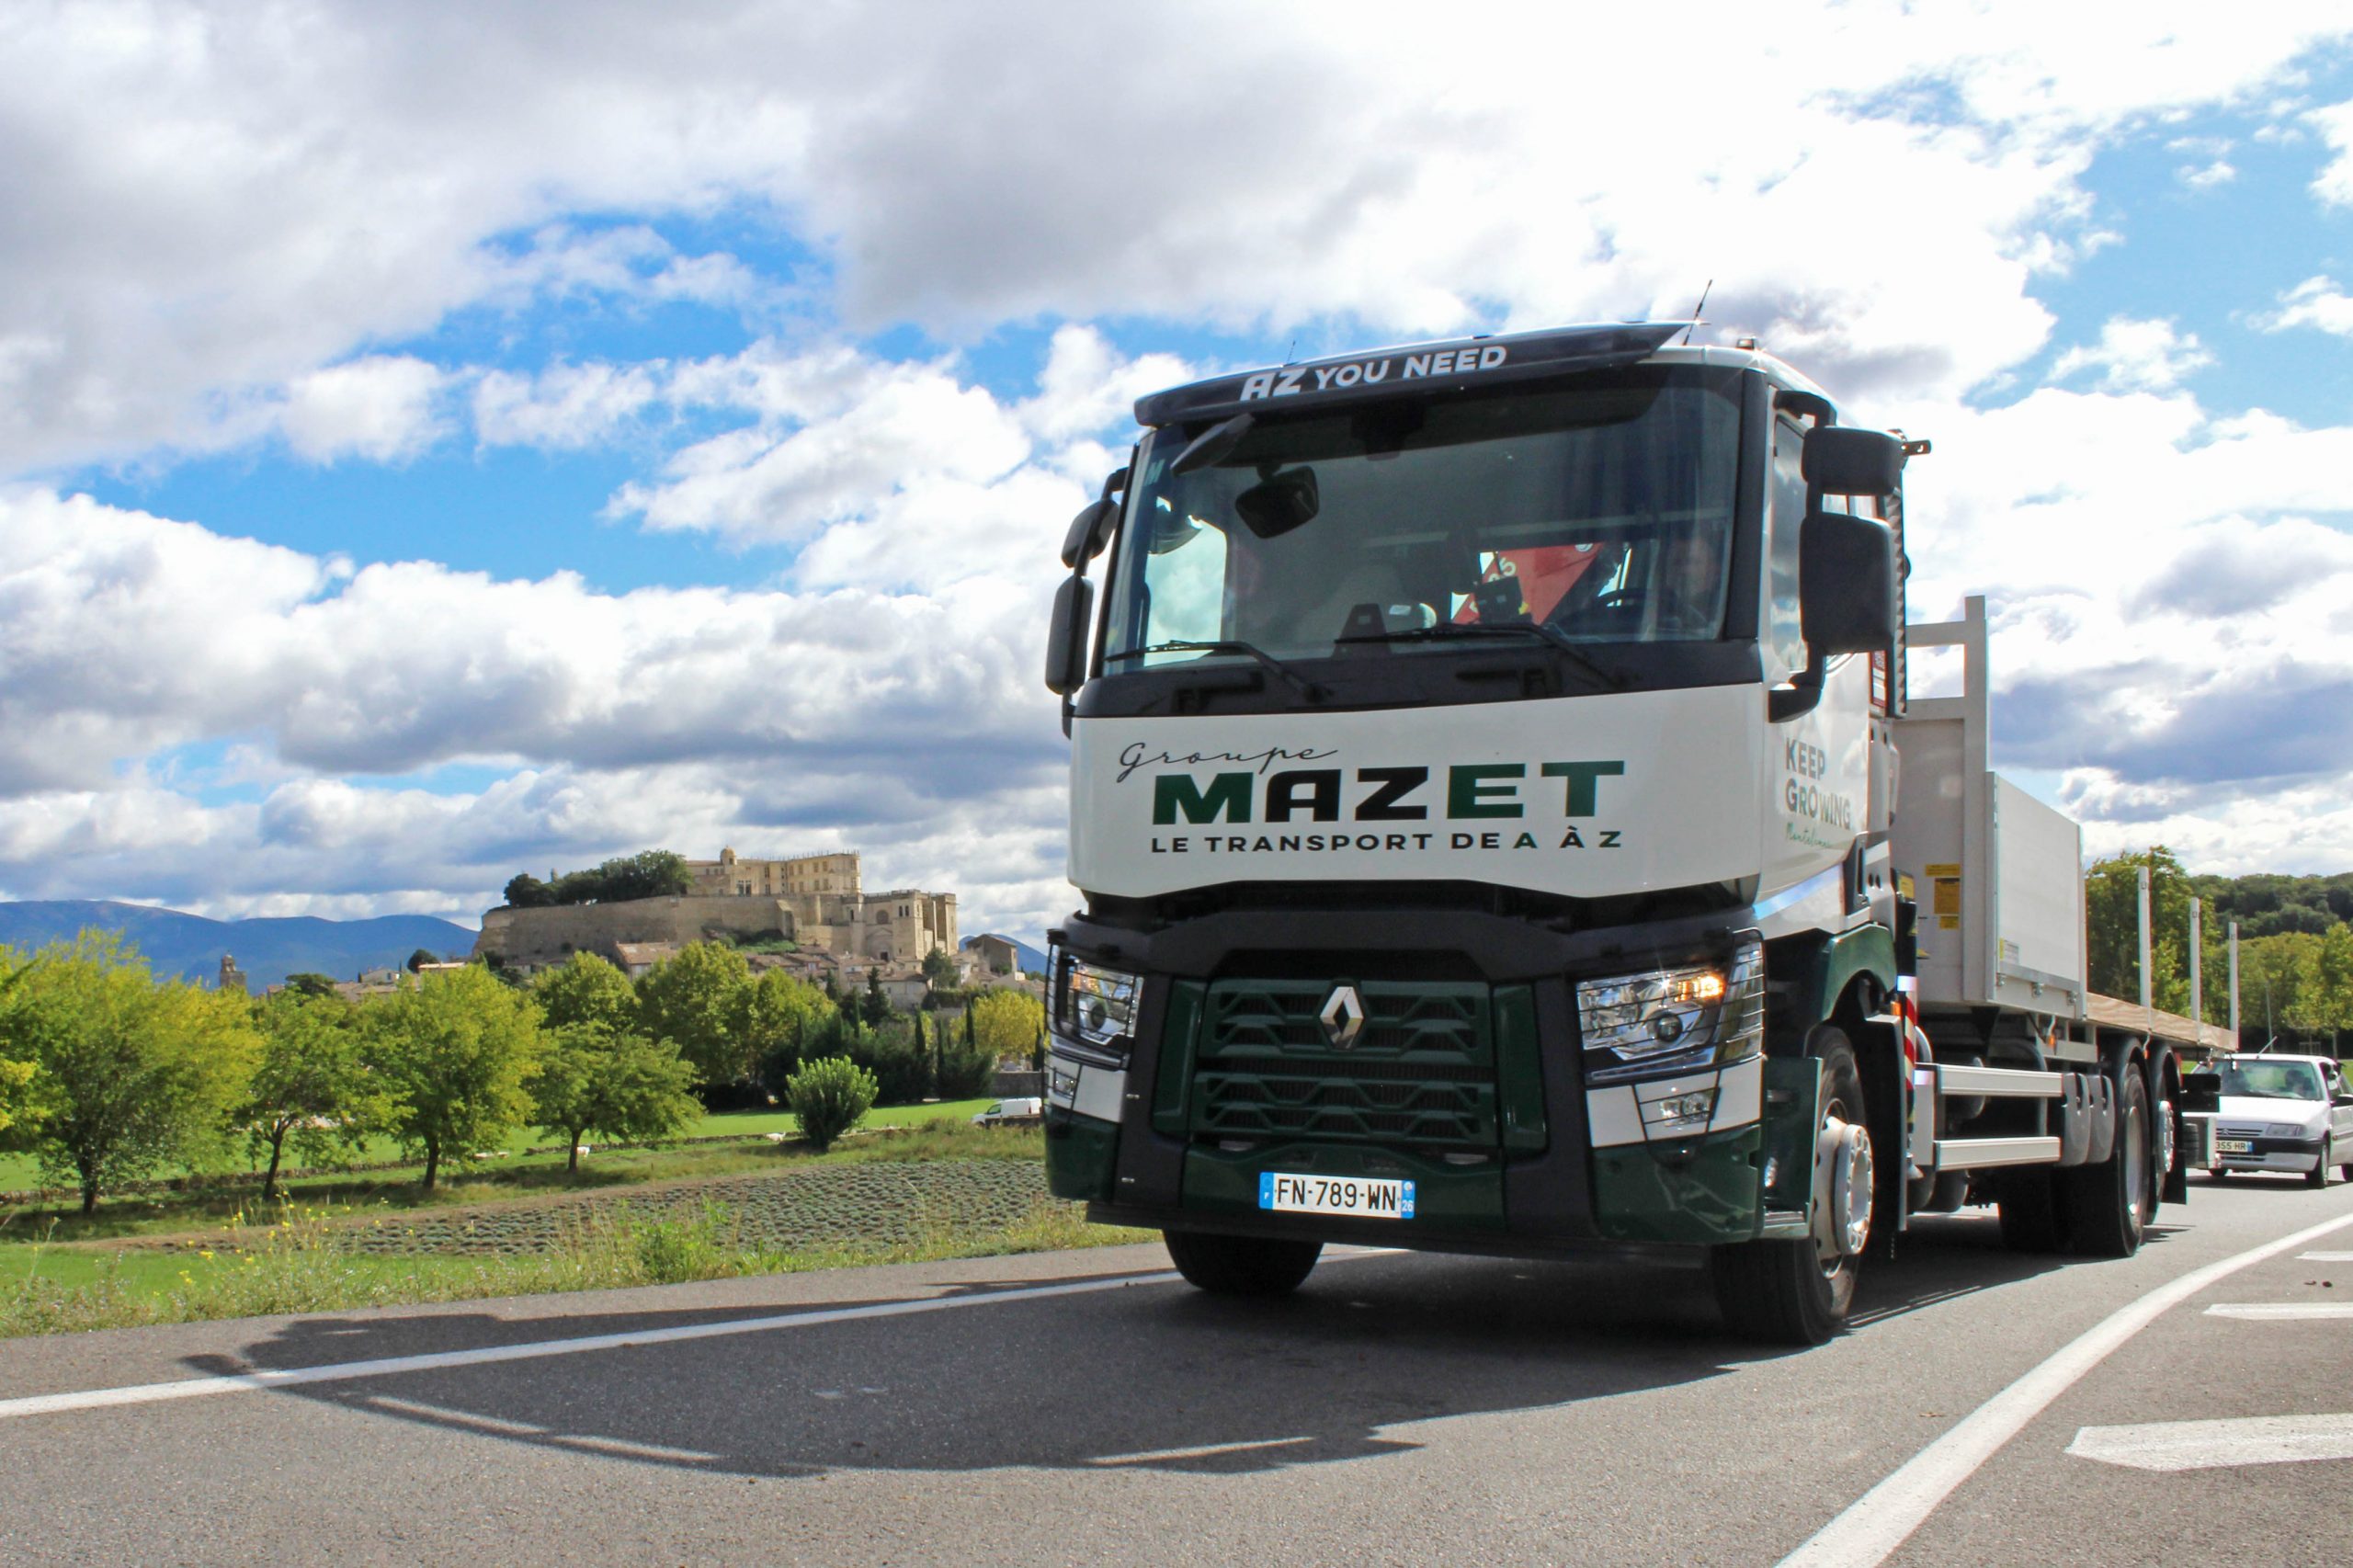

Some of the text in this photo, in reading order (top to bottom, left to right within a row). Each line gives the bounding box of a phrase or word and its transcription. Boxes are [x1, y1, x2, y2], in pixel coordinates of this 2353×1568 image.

[1240, 346, 1506, 401] AZ YOU NEED
[1117, 742, 1338, 783] Groupe
[1785, 737, 1825, 780] KEEP
[1152, 760, 1625, 825] MAZET
[1785, 778, 1851, 830] GROWING
[1152, 836, 1189, 853] LE
[1204, 834, 1433, 852] TRANSPORT
[1560, 825, 1585, 848] À
[1598, 831, 1621, 847] Z
[1277, 1178, 1396, 1210] FN-789-WN
[1402, 1199, 1414, 1212] 26
